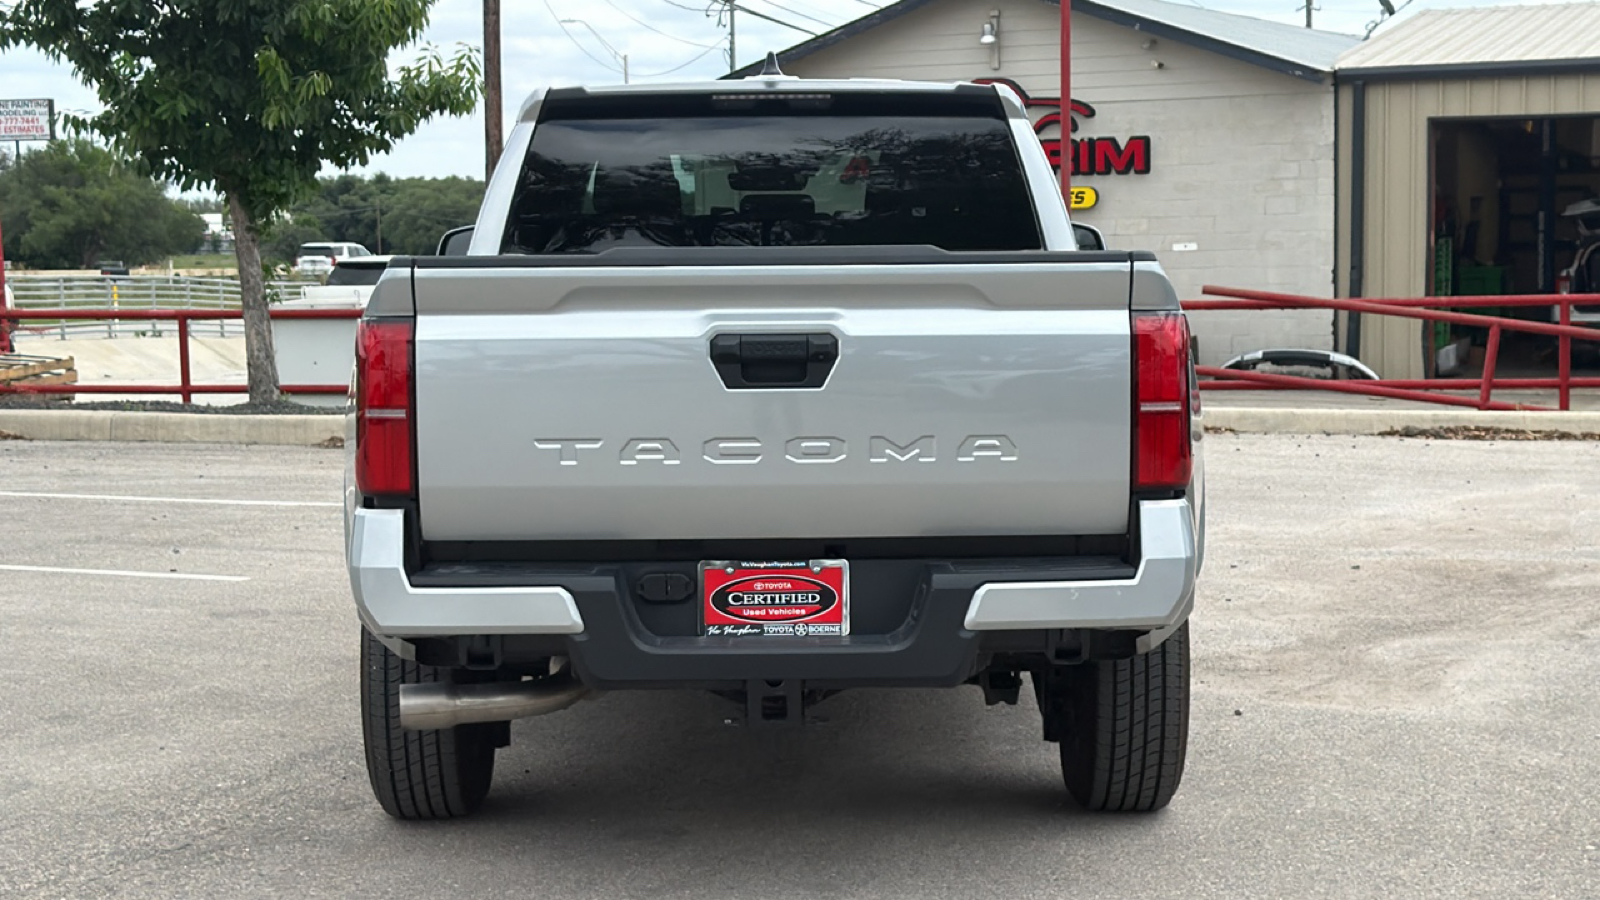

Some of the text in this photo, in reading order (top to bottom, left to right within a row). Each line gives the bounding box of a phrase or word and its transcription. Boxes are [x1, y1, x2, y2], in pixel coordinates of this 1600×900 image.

[11, 101, 48, 109] PAINTING
[4, 126, 45, 134] ESTIMATES
[534, 435, 1019, 466] TACOMA
[741, 561, 806, 569] VicVaughanToyota.com
[728, 592, 820, 605] CERTIFIED
[809, 625, 841, 633] BOERNE
